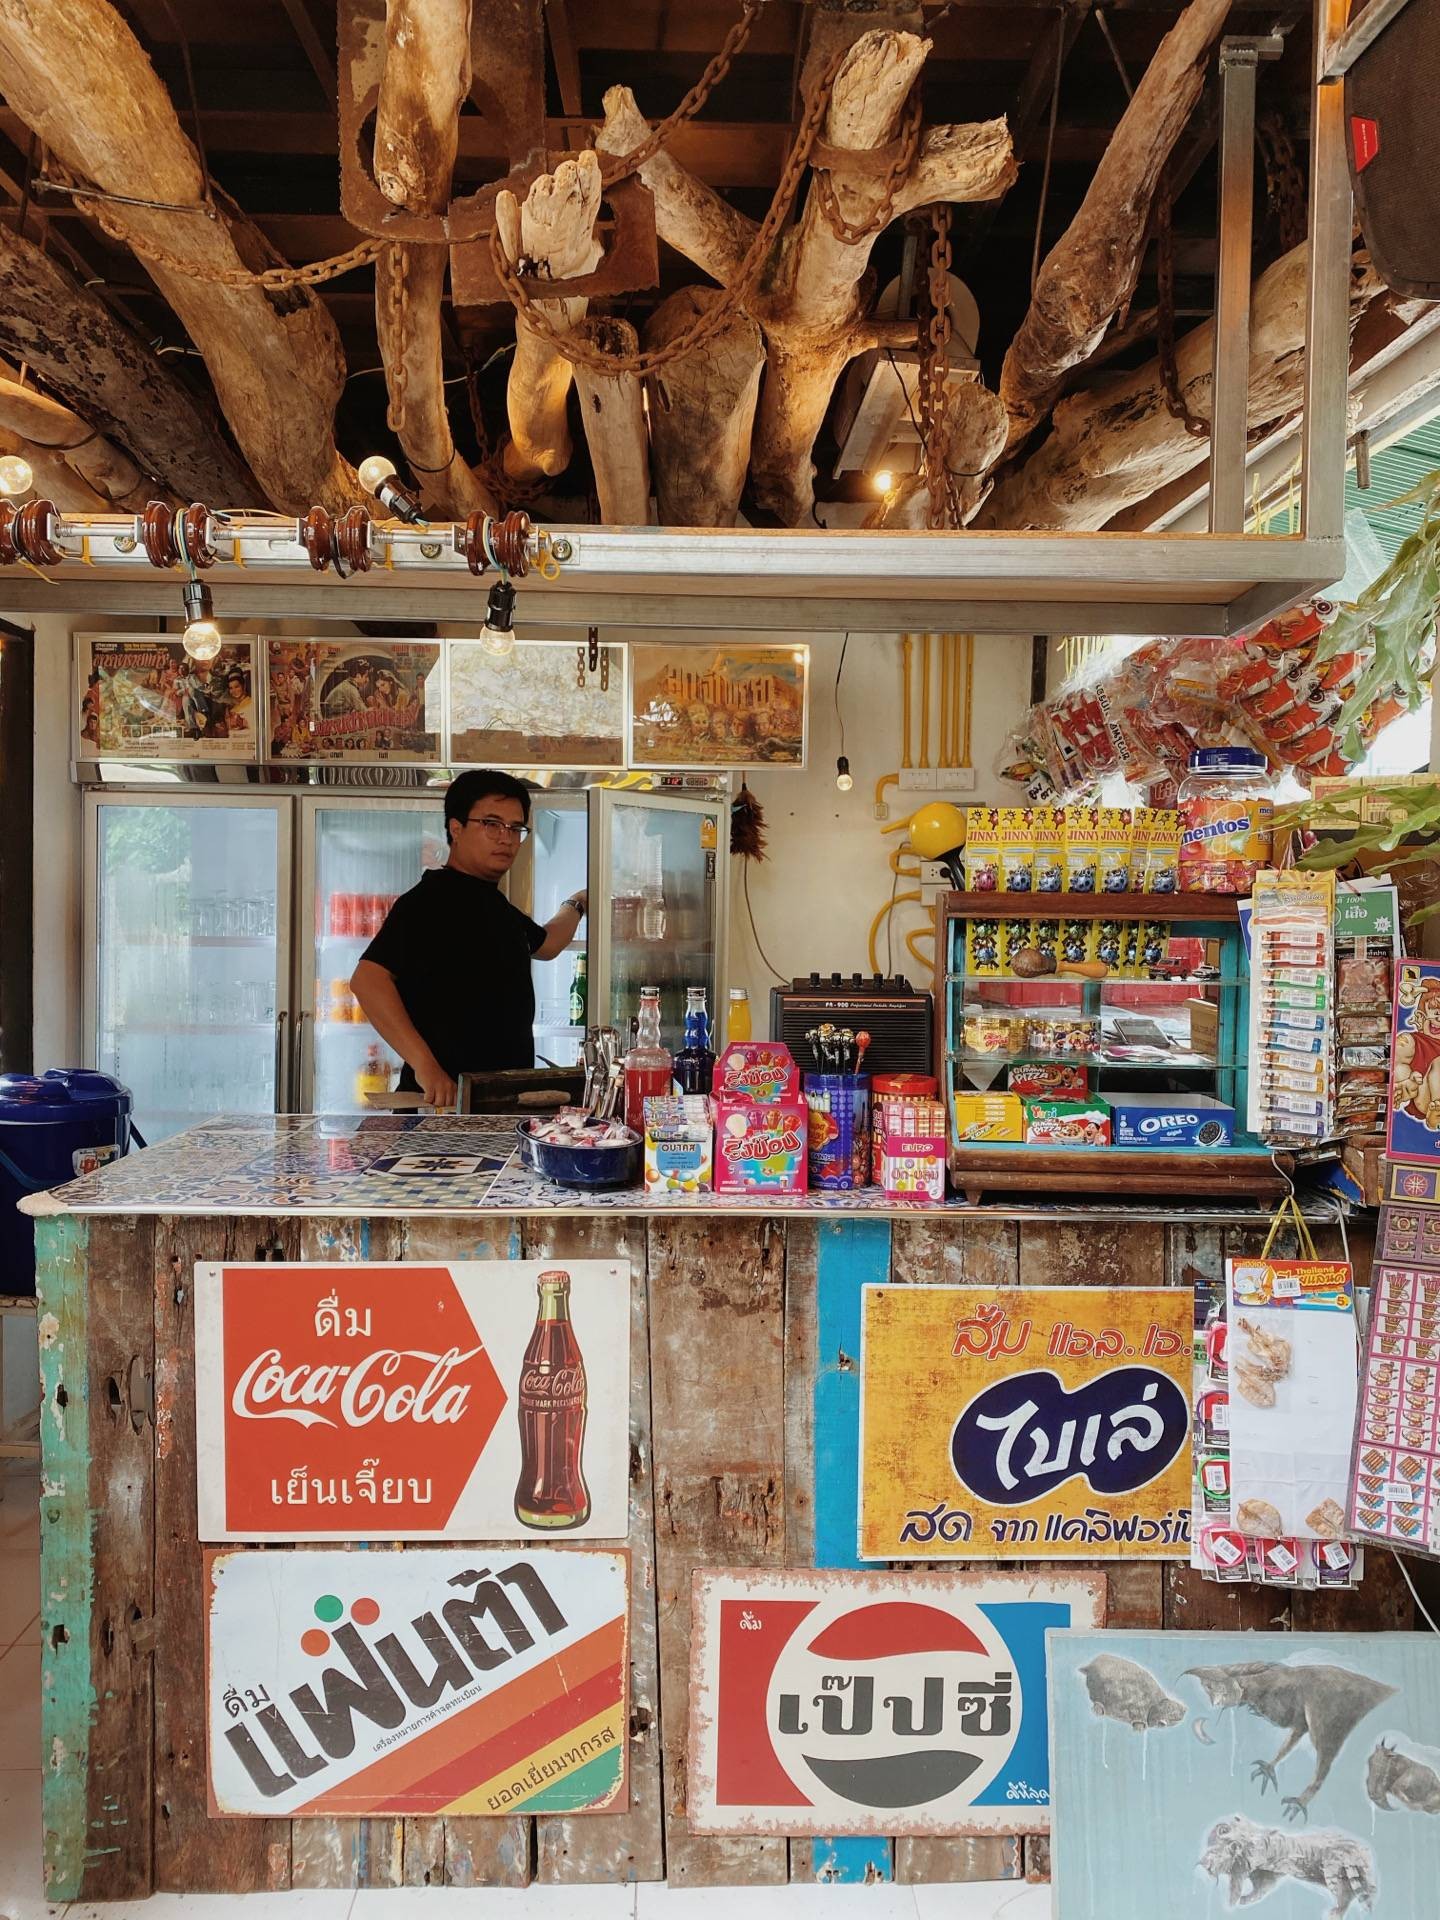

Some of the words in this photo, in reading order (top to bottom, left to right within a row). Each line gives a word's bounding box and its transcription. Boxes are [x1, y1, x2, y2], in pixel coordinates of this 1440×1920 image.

[1035, 831, 1064, 841] JINNY
[1101, 830, 1131, 840] JINNY
[1151, 831, 1182, 842] JINNY
[1140, 1114, 1199, 1133] OREO
[901, 1143, 934, 1153] EURO
[1296, 1266, 1335, 1274] Thailand
[314, 1288, 371, 1337] ดื่ม
[951, 1304, 1031, 1361] ส้ม
[232, 1344, 483, 1430] Coca-Cola
[521, 1367, 585, 1397] Coca-Cola
[976, 1382, 1164, 1490] ไบเล่
[271, 1458, 432, 1505] เย็นเจี๊ยบ
[899, 1503, 973, 1543] สด
[991, 1515, 1038, 1543] จาก
[224, 1562, 568, 1798] แฟนต้า
[223, 1682, 270, 1719] ดื่ม
[778, 1671, 1012, 1736] เป๊ปซี่
[486, 1726, 617, 1811] ยอดเยี่ยมทุกรส
